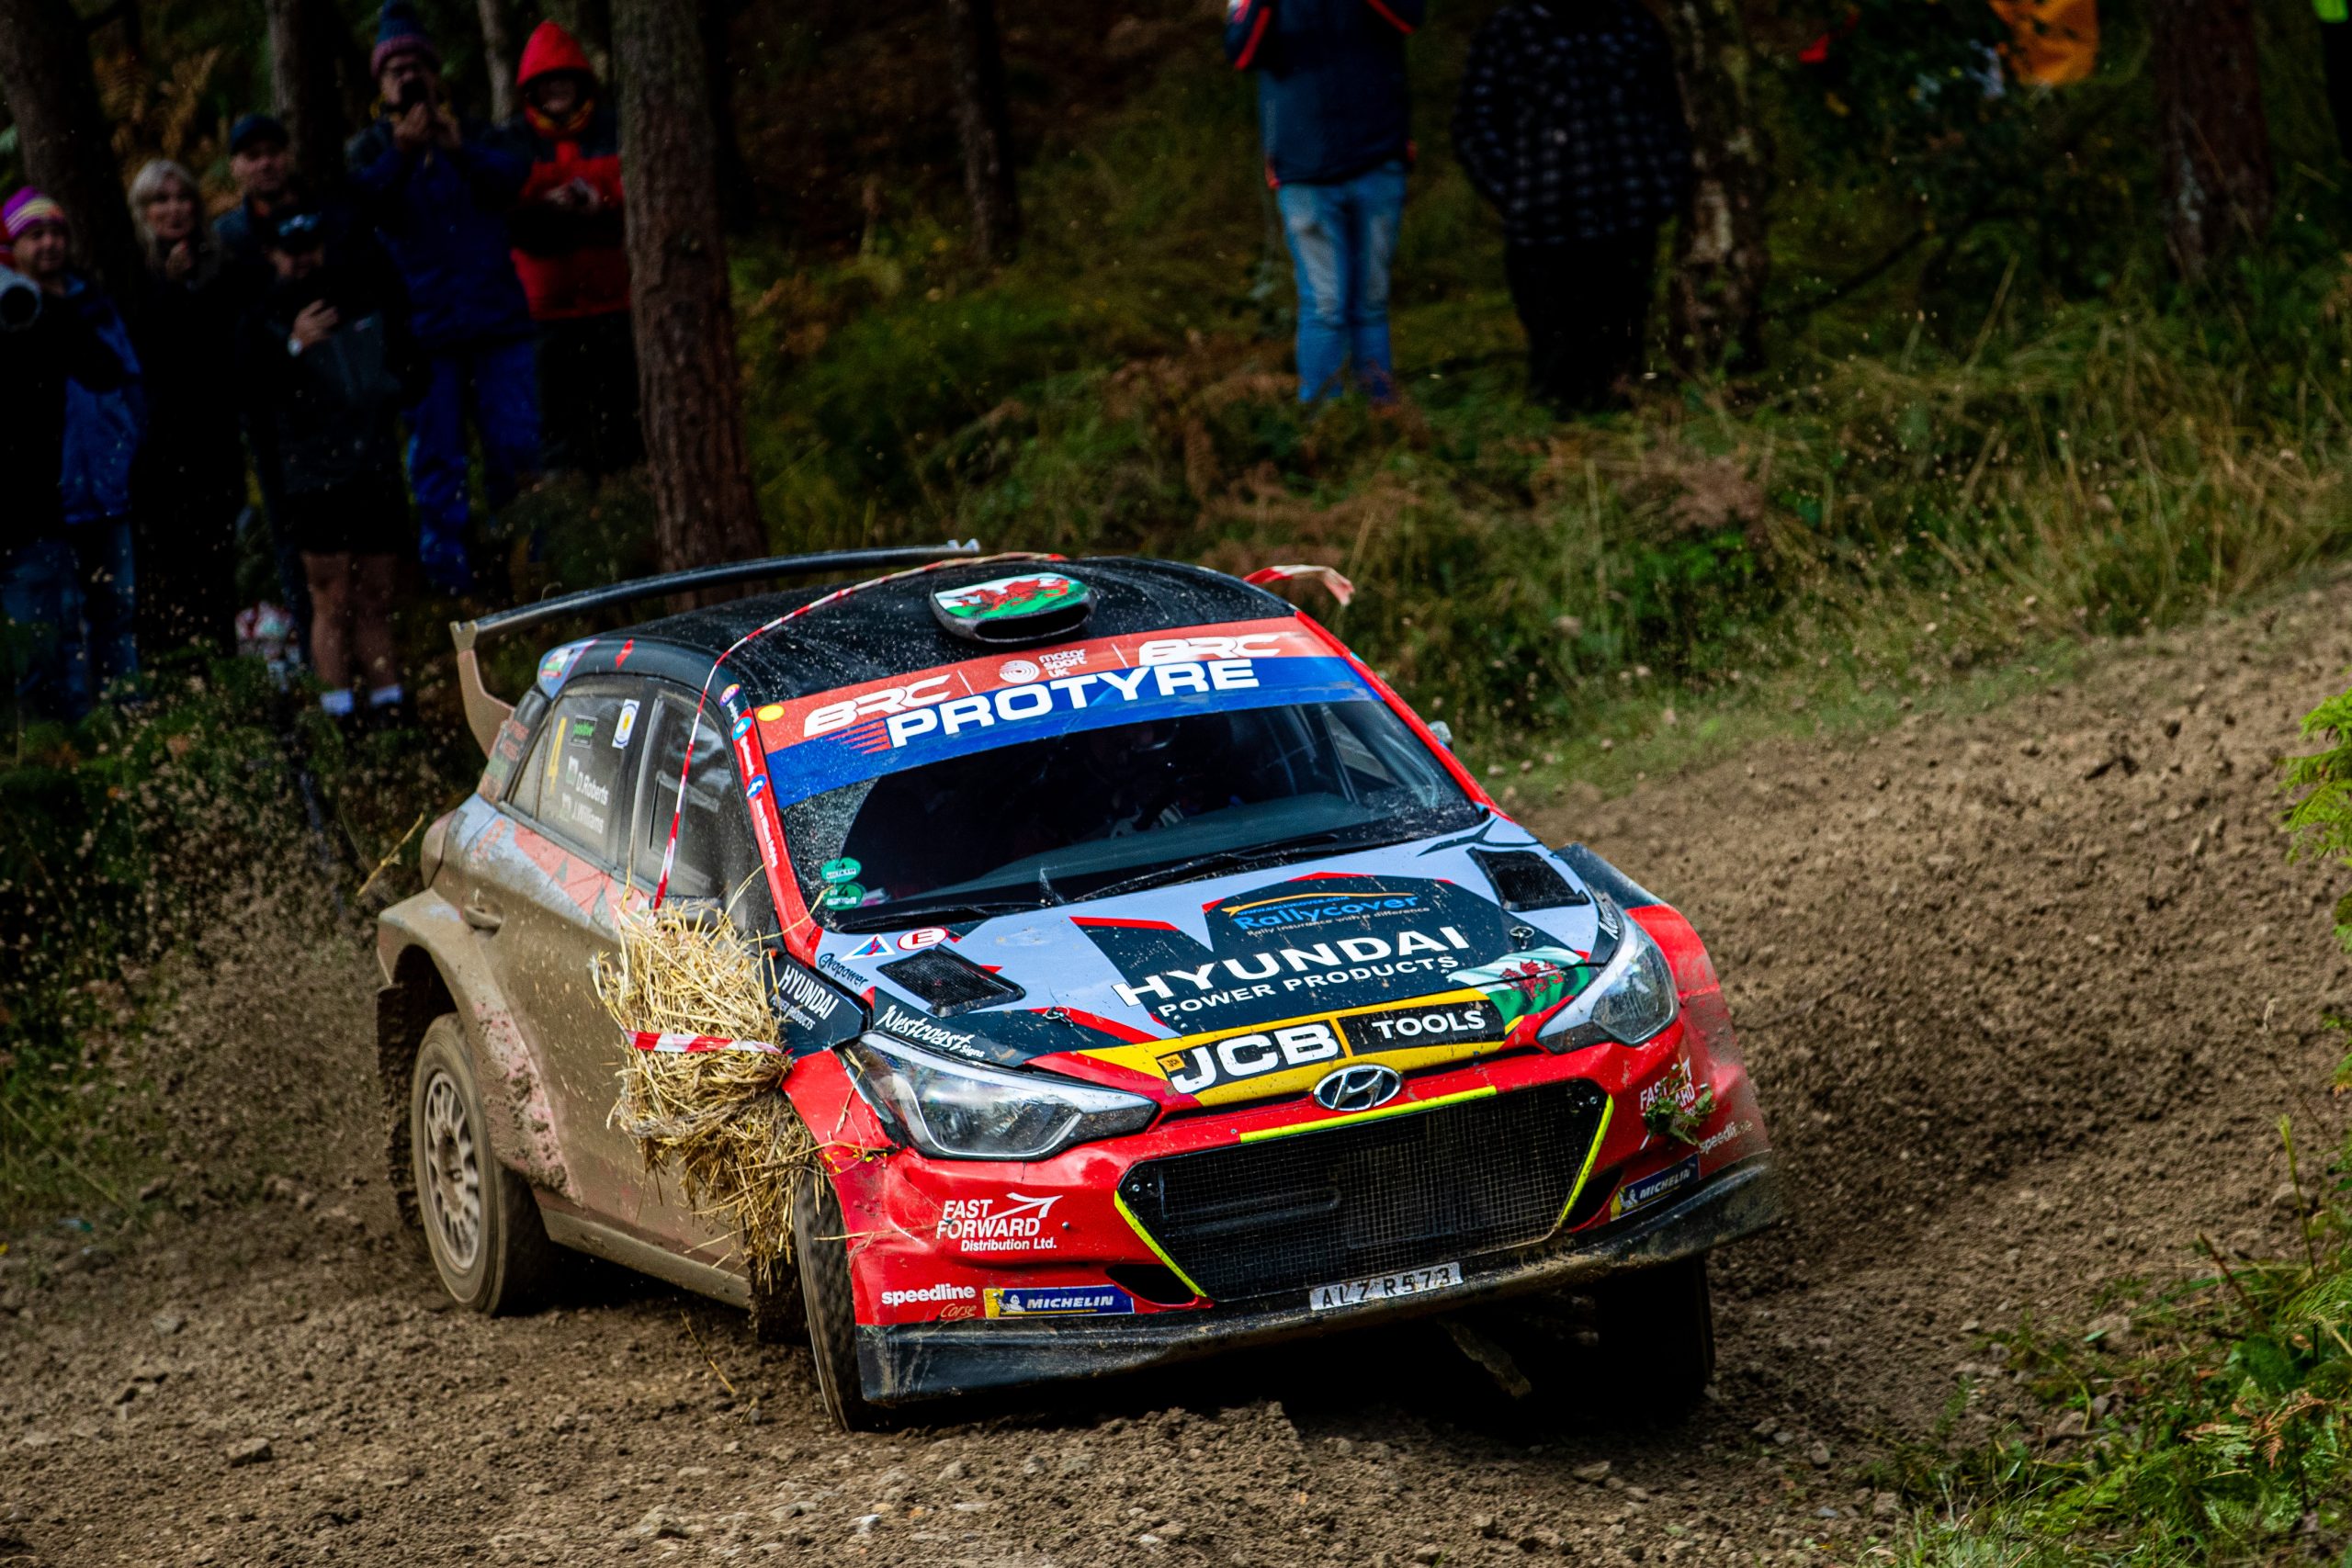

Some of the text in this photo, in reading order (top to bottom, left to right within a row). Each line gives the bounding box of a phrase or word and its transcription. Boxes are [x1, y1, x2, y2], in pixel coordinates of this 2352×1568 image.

[1039, 649, 1086, 663] motor
[1044, 658, 1088, 671] sport
[1139, 635, 1281, 666] BRC
[1047, 668, 1070, 678] UK
[804, 674, 951, 737] BRC
[886, 659, 1260, 749] PROTYRE
[1234, 896, 1419, 931] Rallycover
[1111, 926, 1470, 1007] HYUNDAI
[777, 964, 839, 1021] HYUNDAI
[1158, 955, 1459, 1017] POWER PRODUCTS
[876, 1004, 976, 1052] Westcoast
[1170, 1010, 1486, 1094] JCB TOOLS
[1639, 1168, 1691, 1200] MICHELIN
[942, 1199, 993, 1220] FAST
[936, 1217, 1040, 1239] FORWARD
[960, 1236, 1057, 1252] Distribution Ltd.
[881, 1283, 976, 1307] speedline
[940, 1303, 977, 1318] Corse
[1026, 1295, 1114, 1310] MICHELIN
